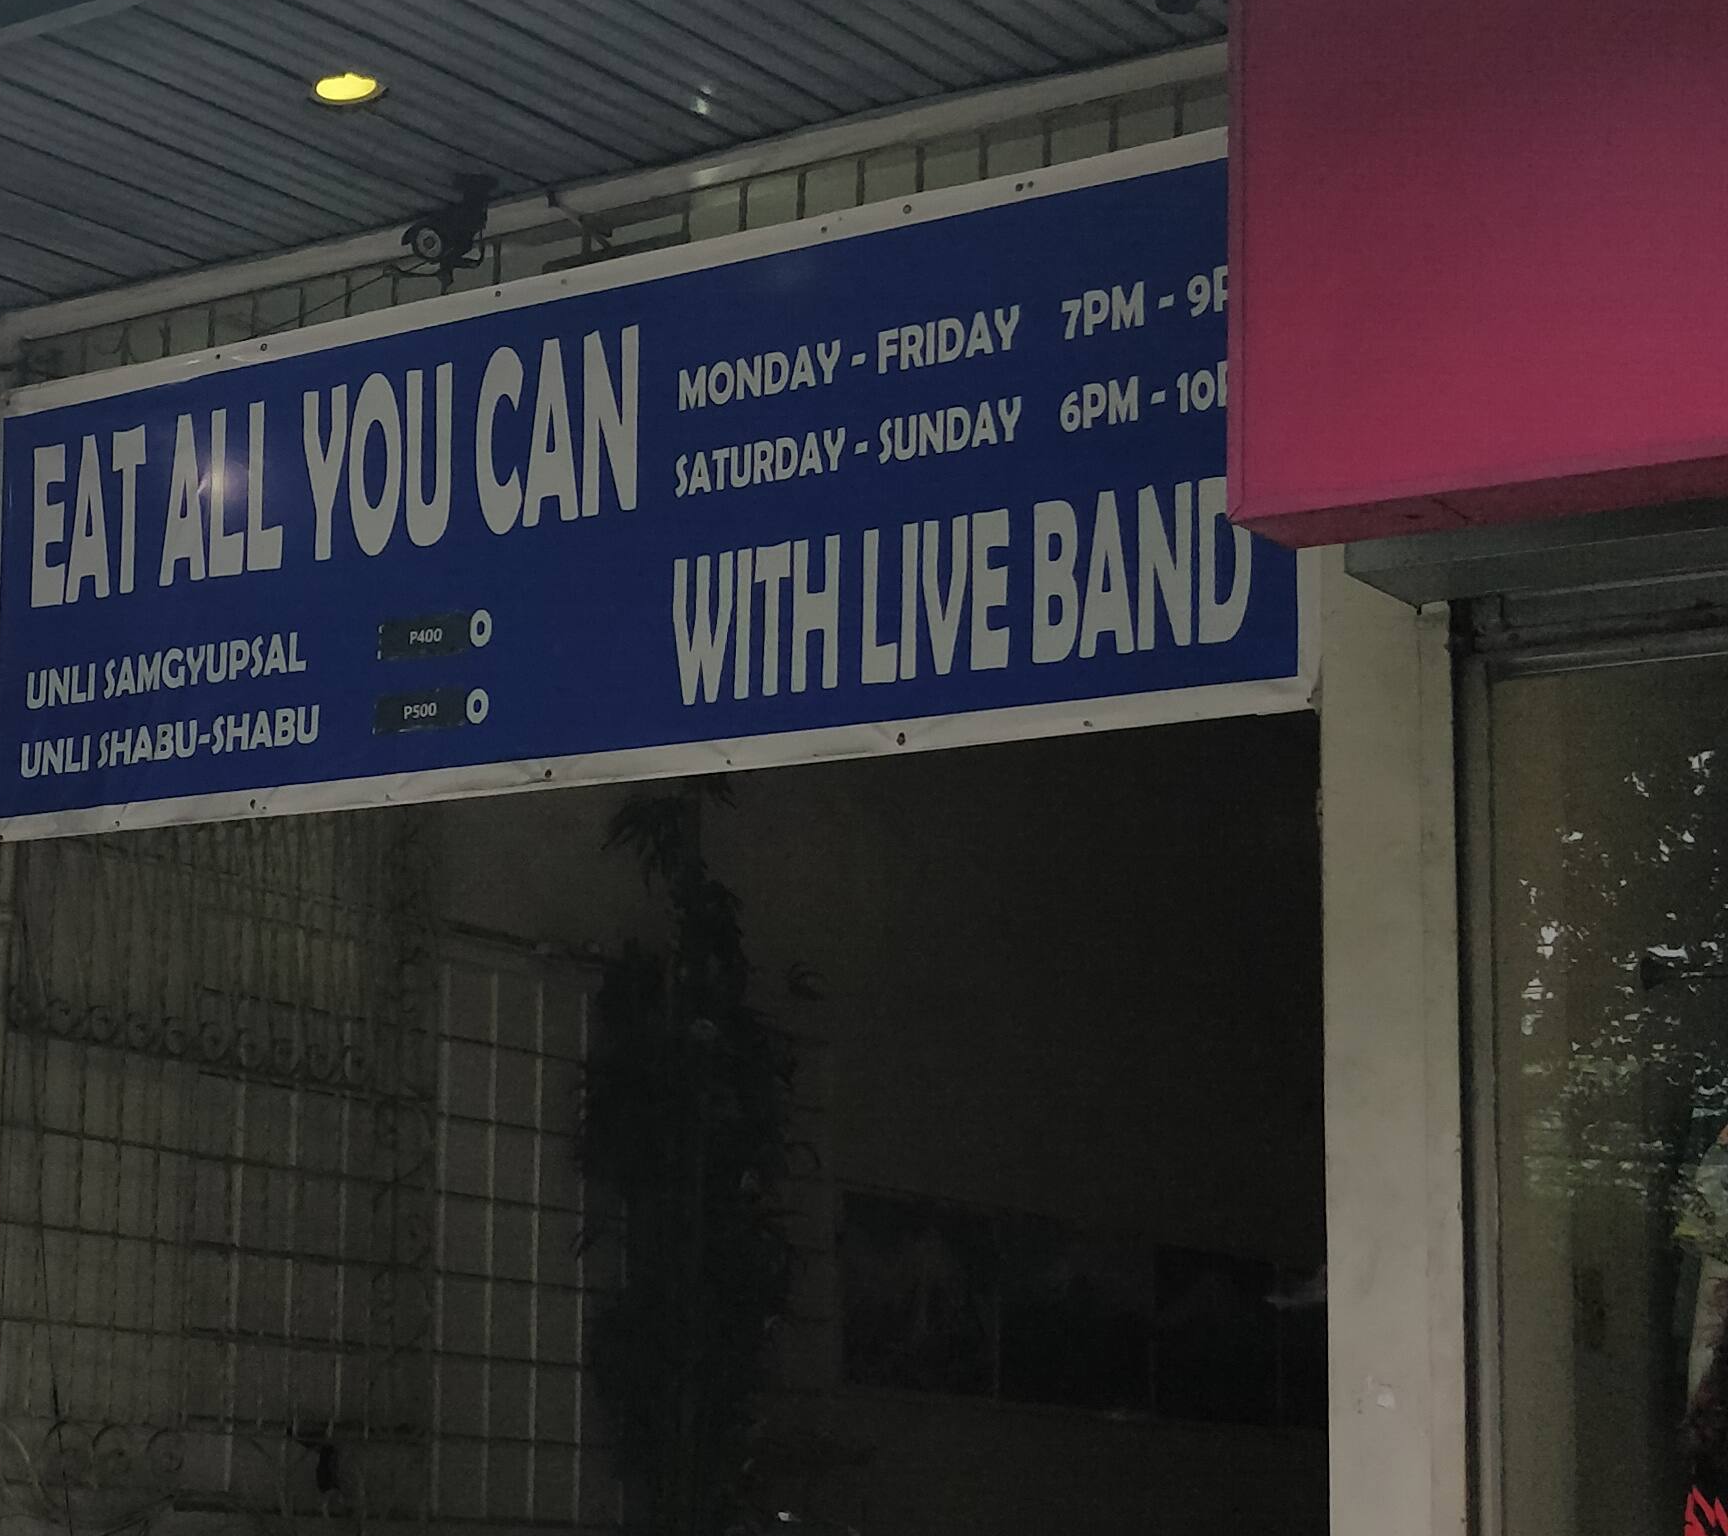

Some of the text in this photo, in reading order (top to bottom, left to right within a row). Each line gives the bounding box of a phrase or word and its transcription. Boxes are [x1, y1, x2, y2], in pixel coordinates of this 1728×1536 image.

[677, 338, 842, 412] MONDAY
[877, 304, 1021, 375] FRIDAY
[1060, 280, 1146, 341] 7PM
[1186, 264, 1229, 318] 9P
[30, 323, 641, 609] EAT ALL YOU CAN
[674, 426, 846, 499] SATURDAY
[877, 395, 1023, 464] SUNDAY
[1058, 375, 1140, 434] 6PM
[408, 627, 443, 645] P400
[672, 475, 1253, 707] WITH LIVE BAND
[25, 631, 308, 711] UNLI SAMGYUPSAL
[403, 702, 438, 720] P500
[20, 704, 320, 779] UNLI SHABU-SHABU
